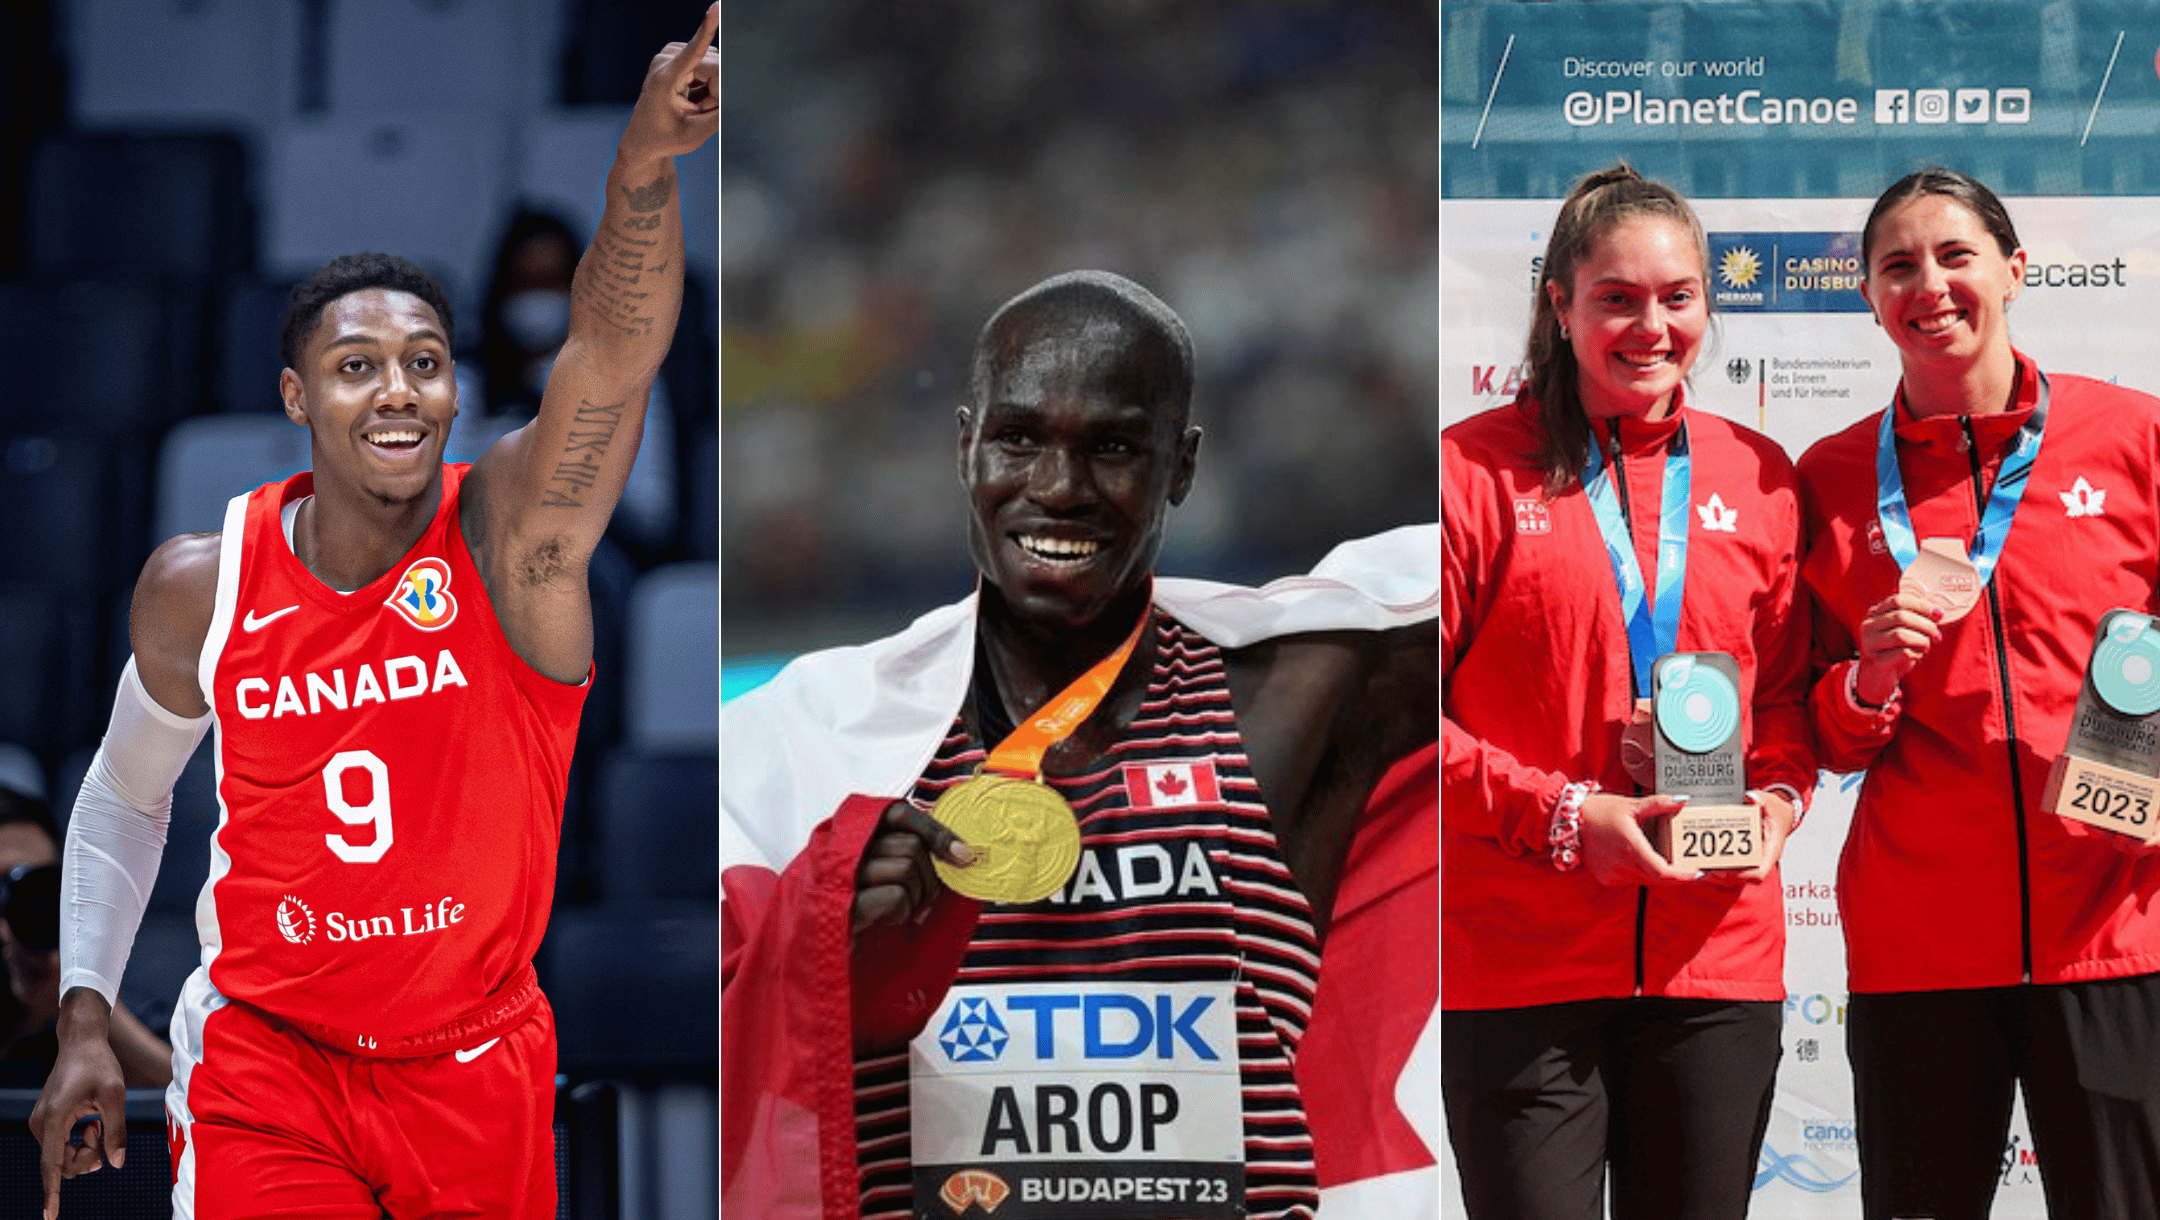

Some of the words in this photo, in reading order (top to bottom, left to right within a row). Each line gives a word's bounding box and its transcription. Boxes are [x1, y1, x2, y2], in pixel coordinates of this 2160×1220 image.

[1564, 57, 1653, 77] Discover
[1661, 60, 1697, 77] our
[1703, 57, 1765, 77] world
[1564, 90, 1857, 126] @PlanetCanoe
[1785, 257, 1860, 273] CASINO
[1772, 357, 1871, 370] Bundesministerium
[1771, 373, 1790, 384] des
[1771, 387, 1792, 398] und
[236, 649, 468, 720] CANADA
[1664, 763, 1735, 778] DUISBURG
[322, 749, 394, 863] 9
[2070, 782, 2150, 825] 2023
[1682, 829, 1753, 858] 2023
[326, 911, 397, 942] Sun
[400, 896, 466, 936] Life
[1006, 994, 1221, 1061] TDK
[980, 1082, 1180, 1156] AROP
[1804, 1125, 1856, 1140] cano
[1020, 1177, 1191, 1203] BUDAPEST
[1196, 1178, 1229, 1202] 23
